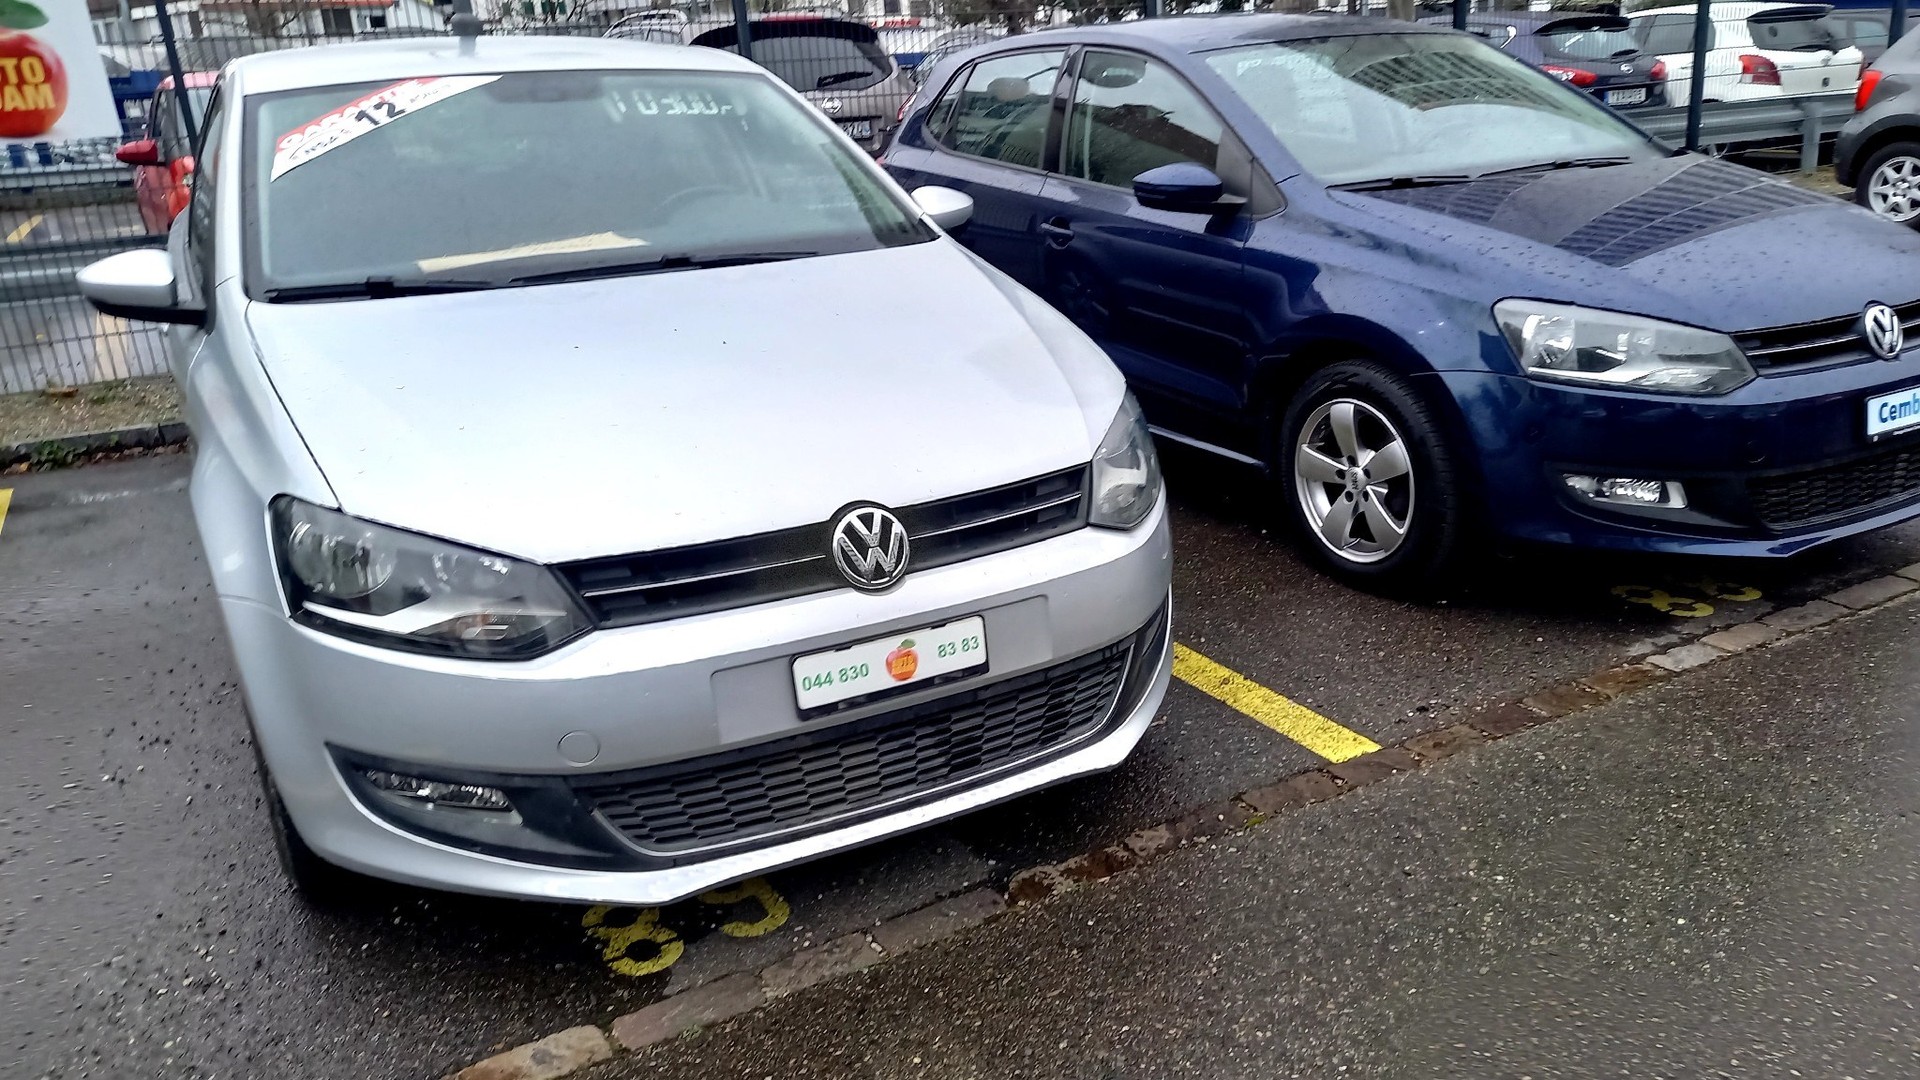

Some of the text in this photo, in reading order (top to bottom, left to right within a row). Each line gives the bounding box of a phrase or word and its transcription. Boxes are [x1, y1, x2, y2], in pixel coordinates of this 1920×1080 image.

[0, 56, 45, 84] TO
[0, 83, 56, 112] AM
[355, 101, 406, 126] 12
[802, 671, 834, 692] 044
[838, 662, 869, 683] 830
[937, 642, 958, 659] 83
[961, 635, 981, 653] 83
